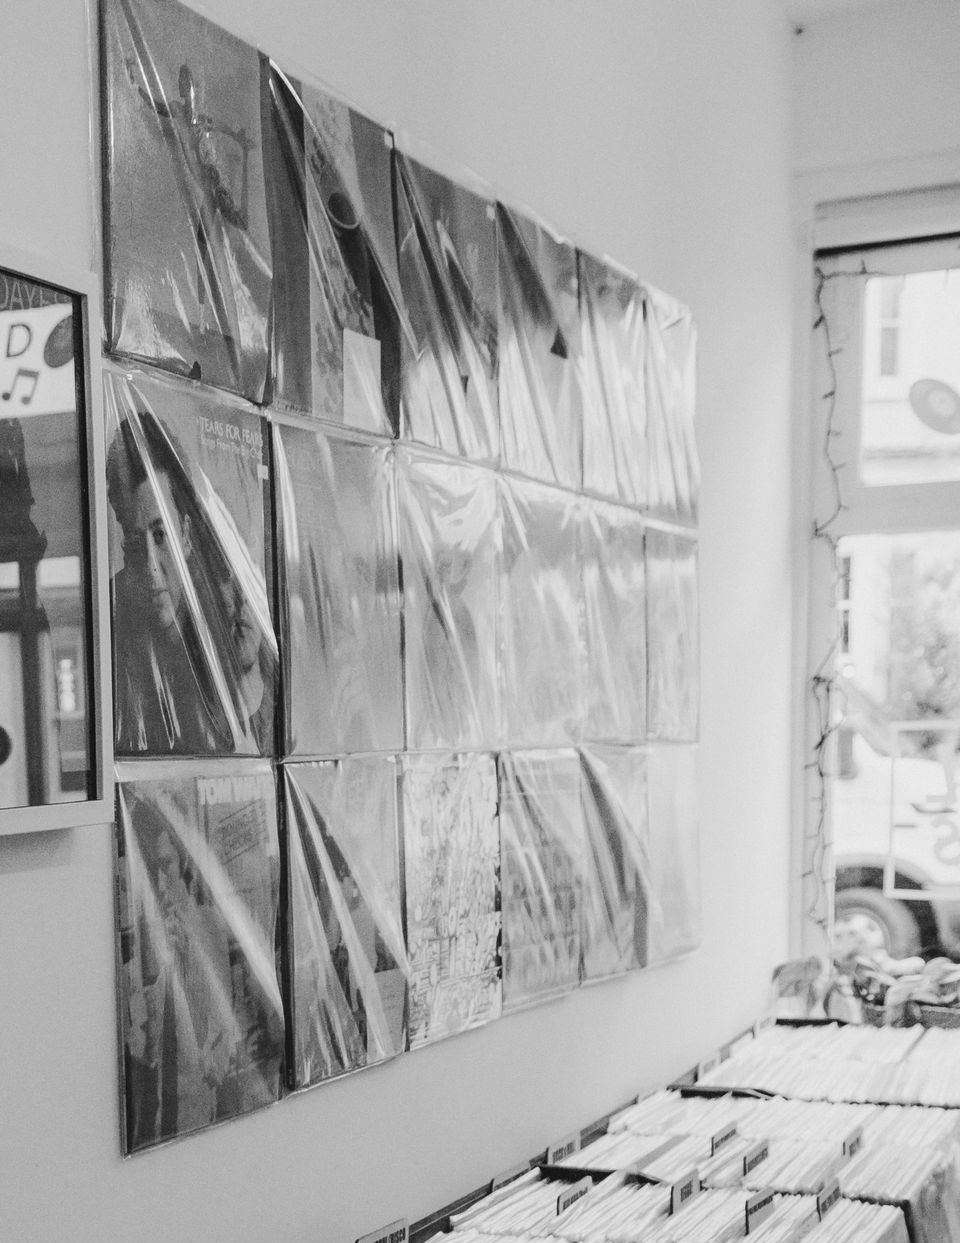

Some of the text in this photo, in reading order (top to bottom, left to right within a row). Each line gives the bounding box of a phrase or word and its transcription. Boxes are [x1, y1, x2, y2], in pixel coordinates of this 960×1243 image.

[199, 415, 263, 447] TEARS FOR FEARS
